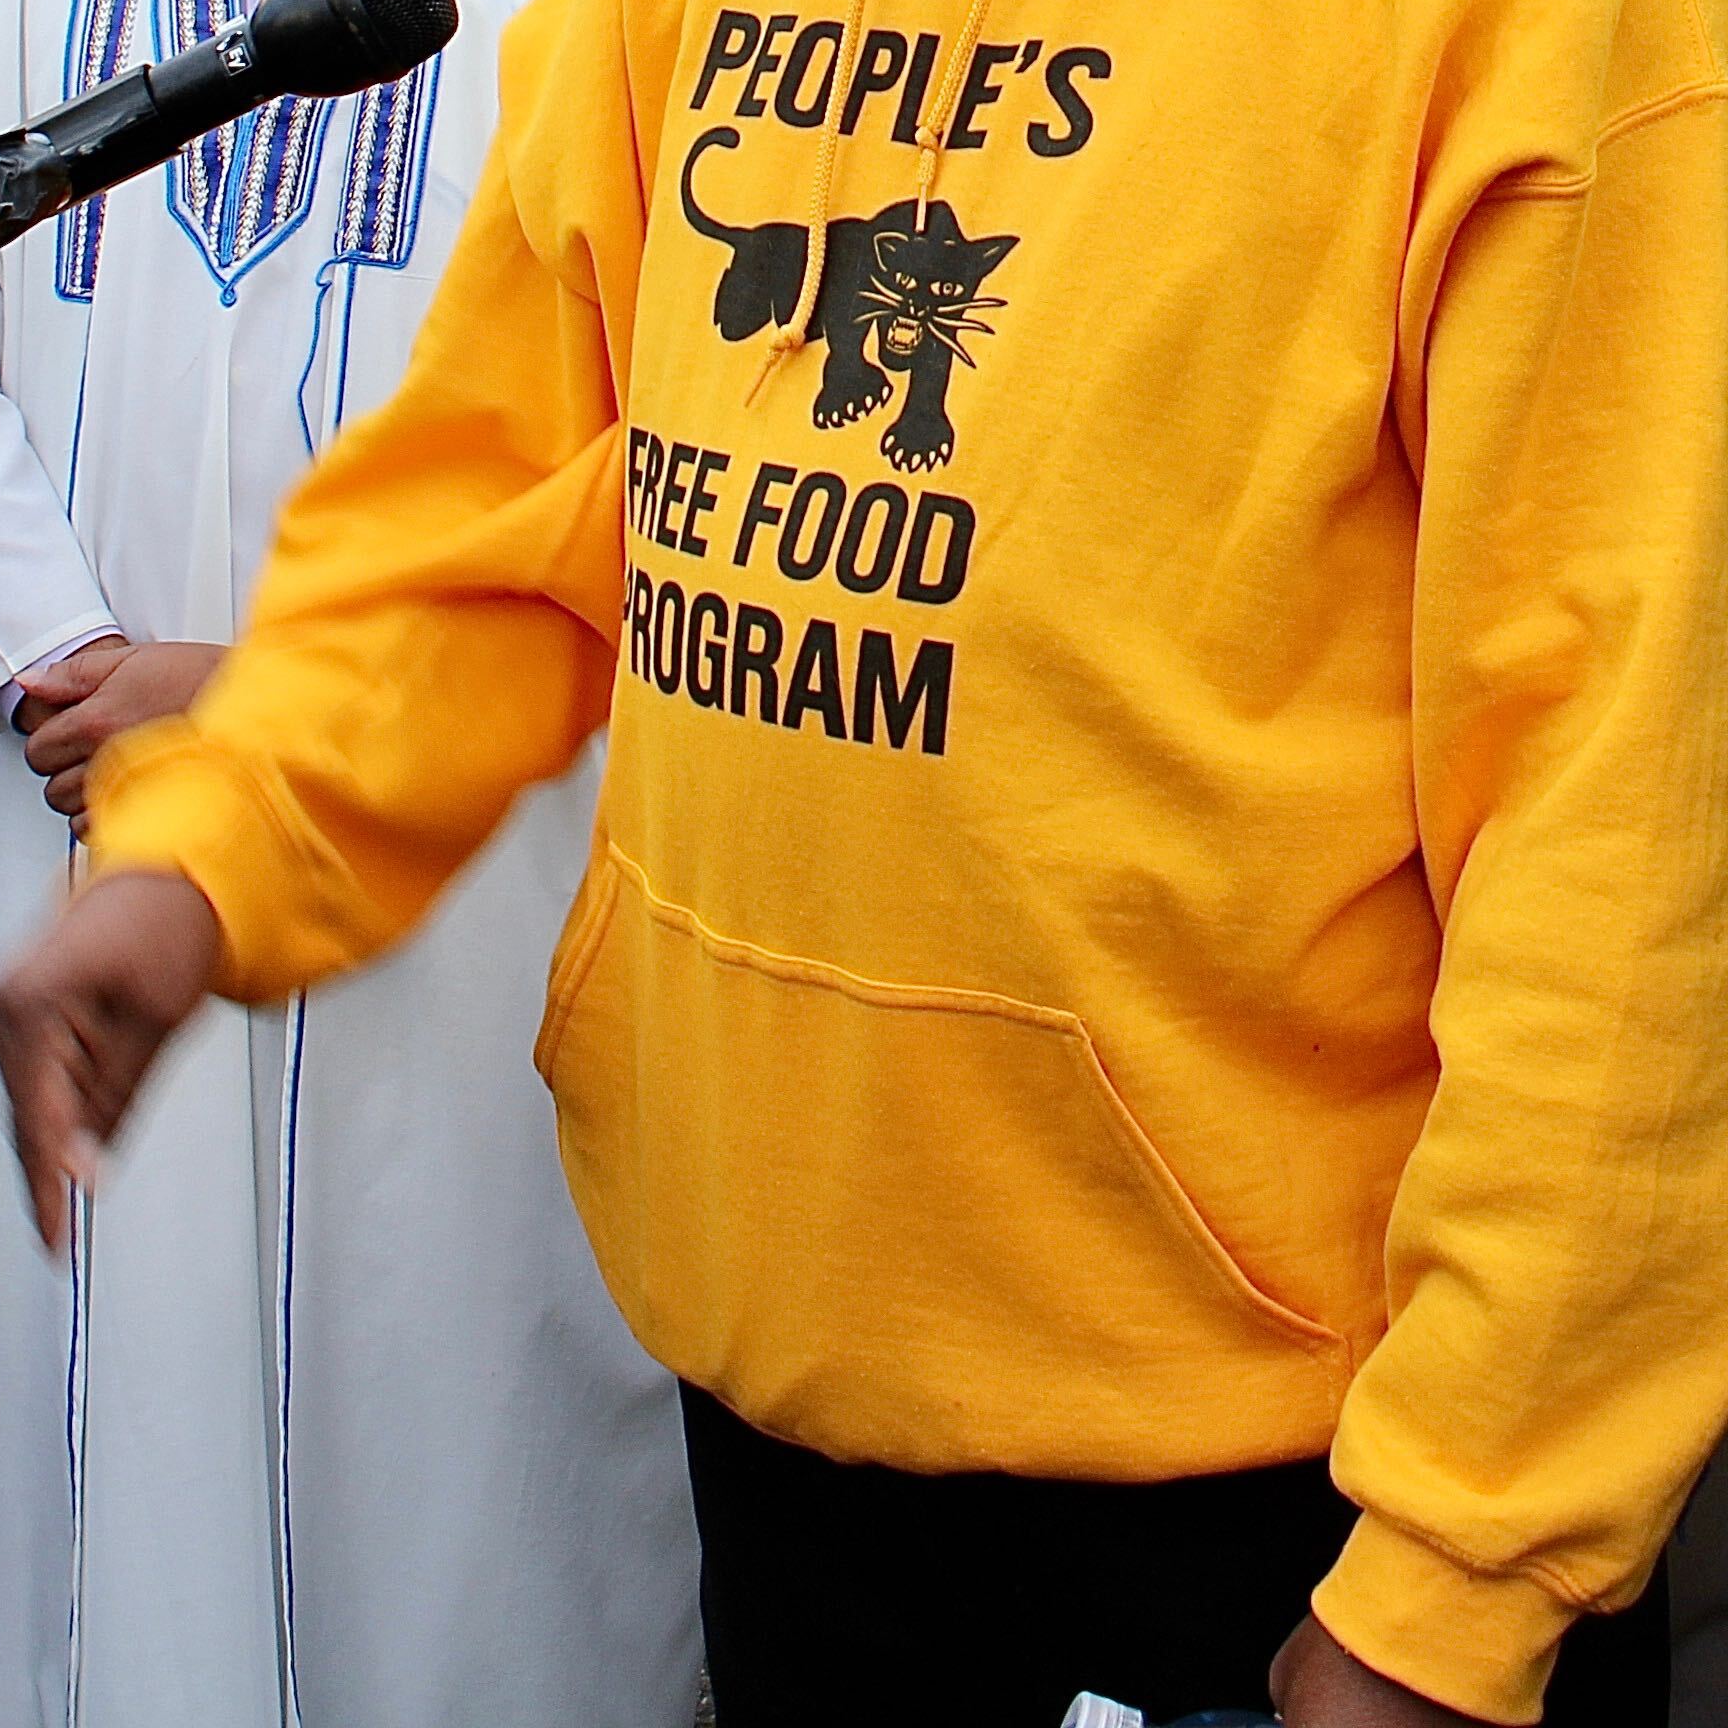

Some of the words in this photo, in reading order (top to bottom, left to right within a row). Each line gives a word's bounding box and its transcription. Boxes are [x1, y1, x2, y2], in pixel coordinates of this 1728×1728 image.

[689, 9, 1112, 158] PEOPLE'S
[628, 426, 732, 558] FREE
[733, 461, 976, 605] FOOD
